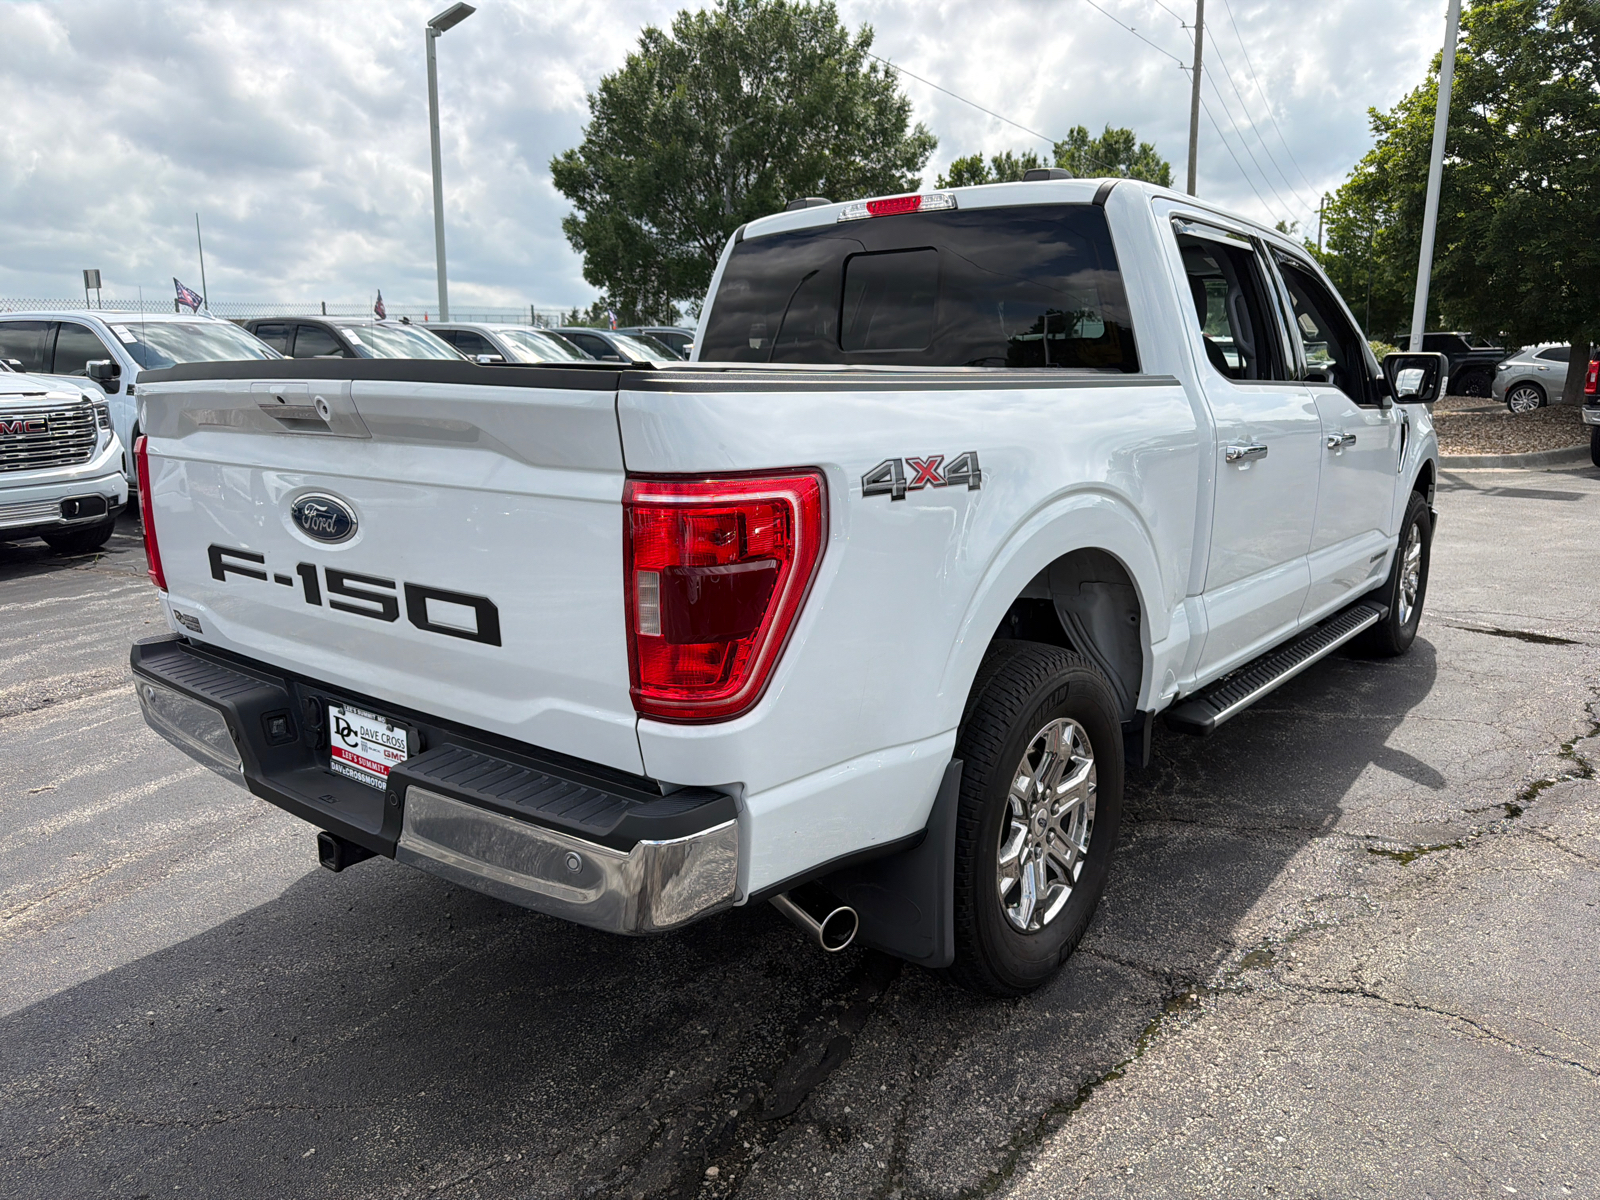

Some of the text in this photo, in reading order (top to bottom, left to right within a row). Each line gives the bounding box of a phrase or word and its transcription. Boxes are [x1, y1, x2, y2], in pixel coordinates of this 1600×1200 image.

[301, 501, 338, 534] Ford
[207, 543, 502, 647] F-150
[333, 715, 359, 748] DC
[360, 726, 405, 750] DAVE CROSS
[341, 749, 358, 762] LEE'S
[383, 749, 406, 762] GMC
